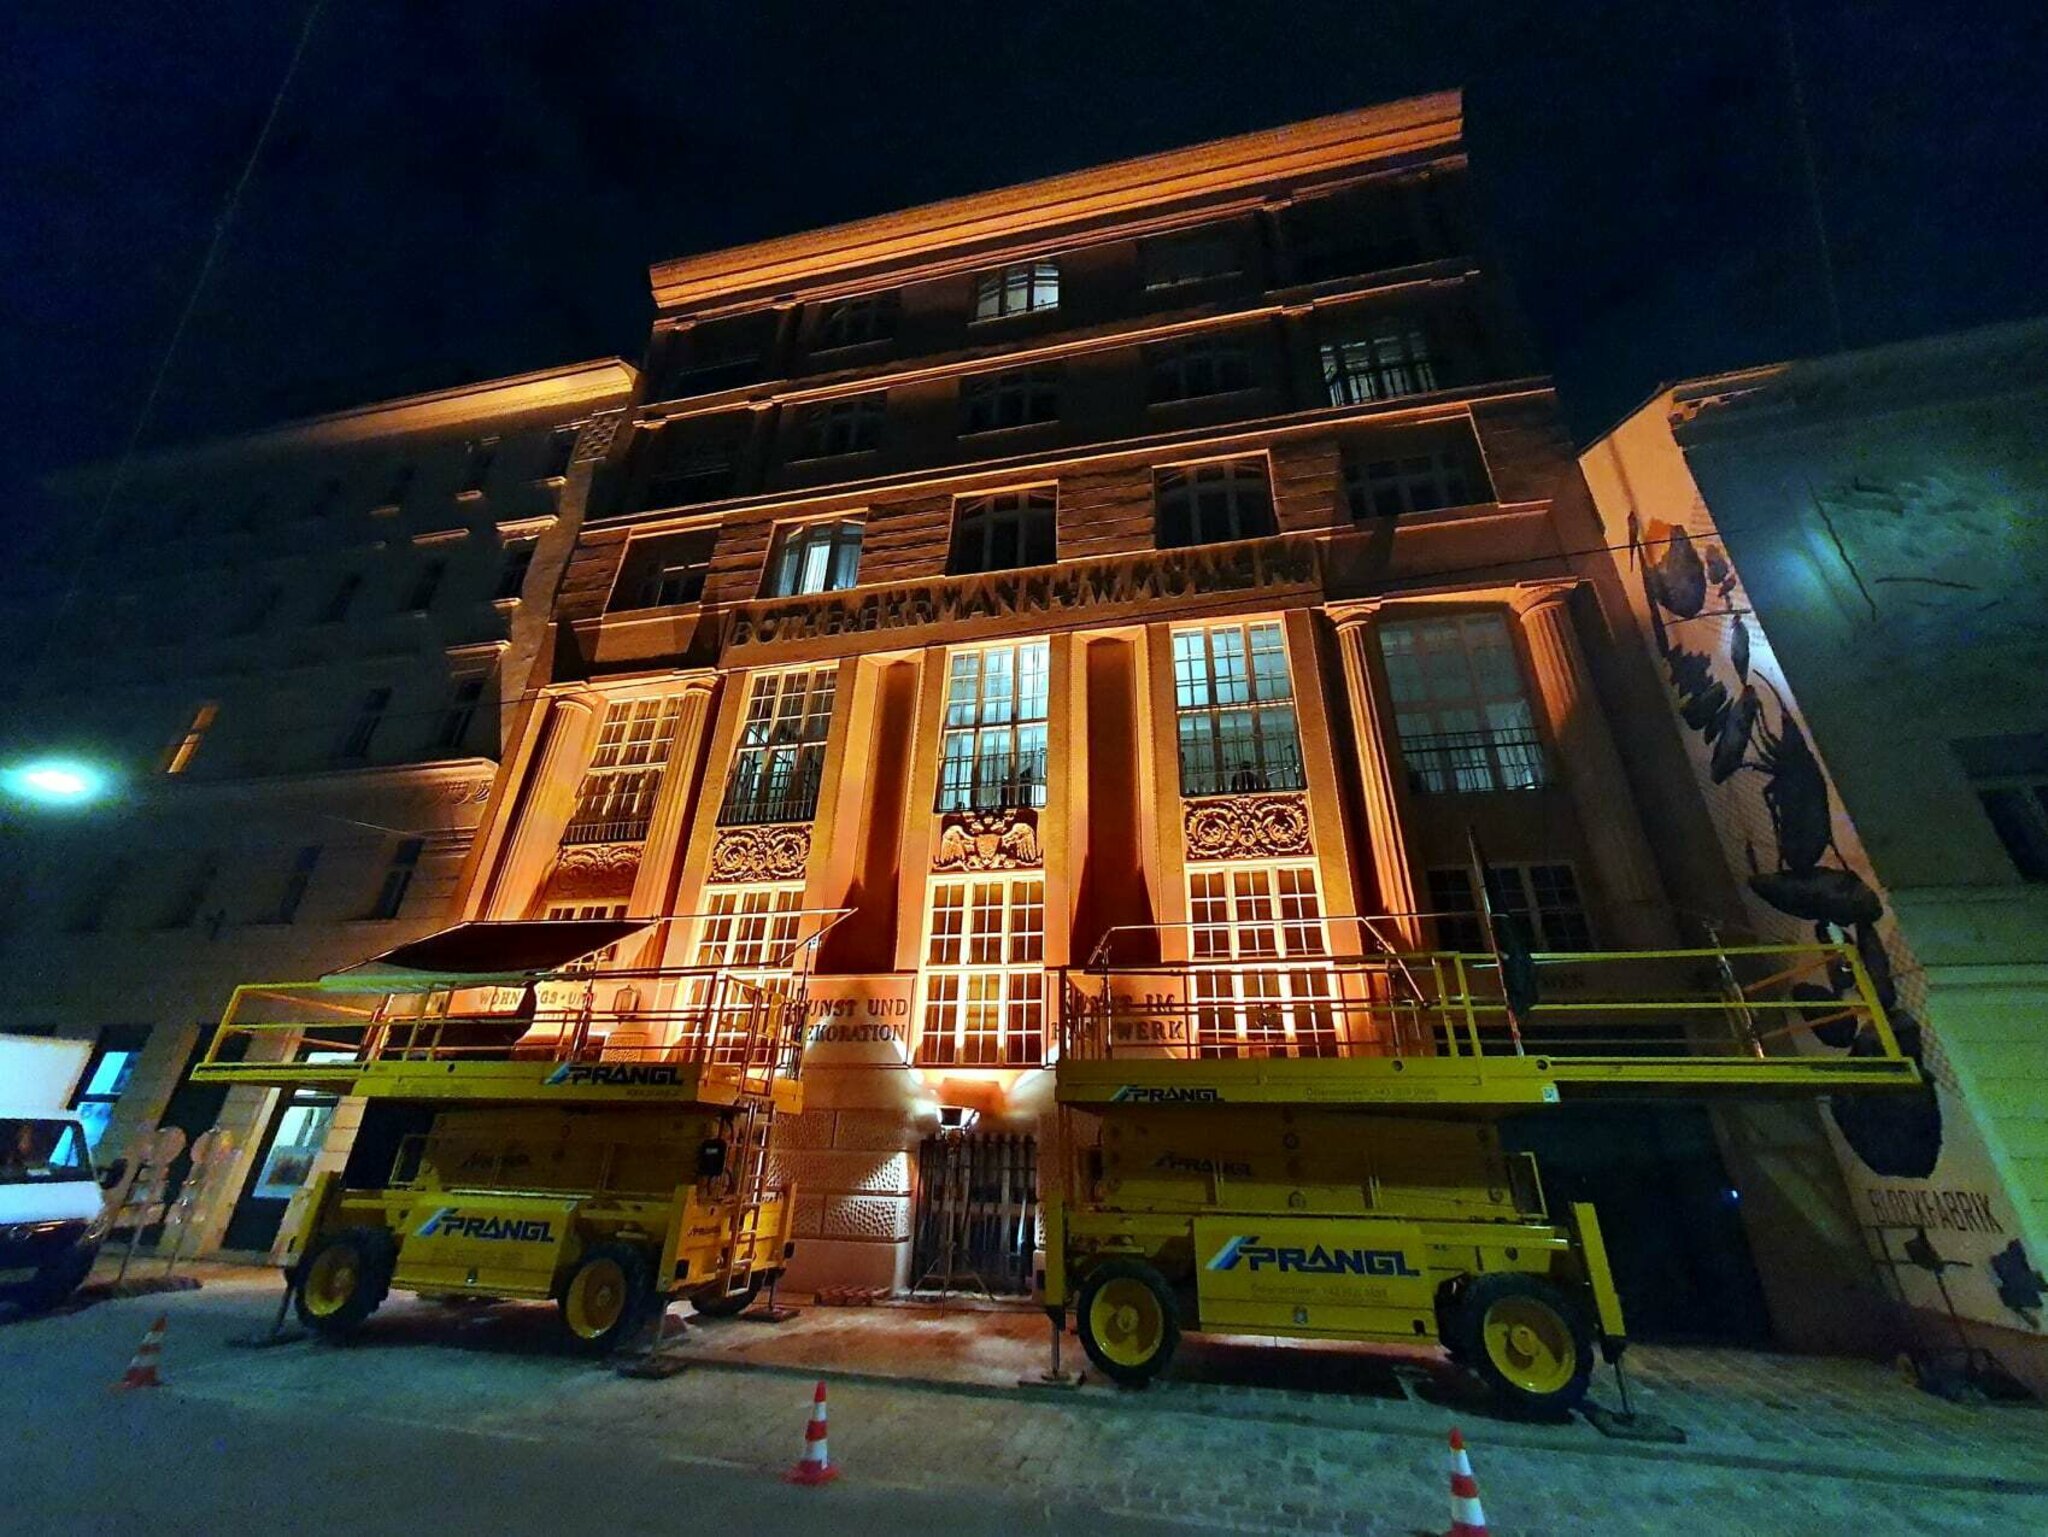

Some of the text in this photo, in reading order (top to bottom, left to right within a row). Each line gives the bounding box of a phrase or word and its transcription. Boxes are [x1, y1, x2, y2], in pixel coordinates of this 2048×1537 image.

[796, 999, 908, 1016] UNST UND
[566, 1063, 683, 1086] PRANGL
[1126, 1085, 1225, 1102] PRANGL
[442, 1216, 554, 1243] PRANGL
[1238, 1243, 1421, 1277] PRANGL
